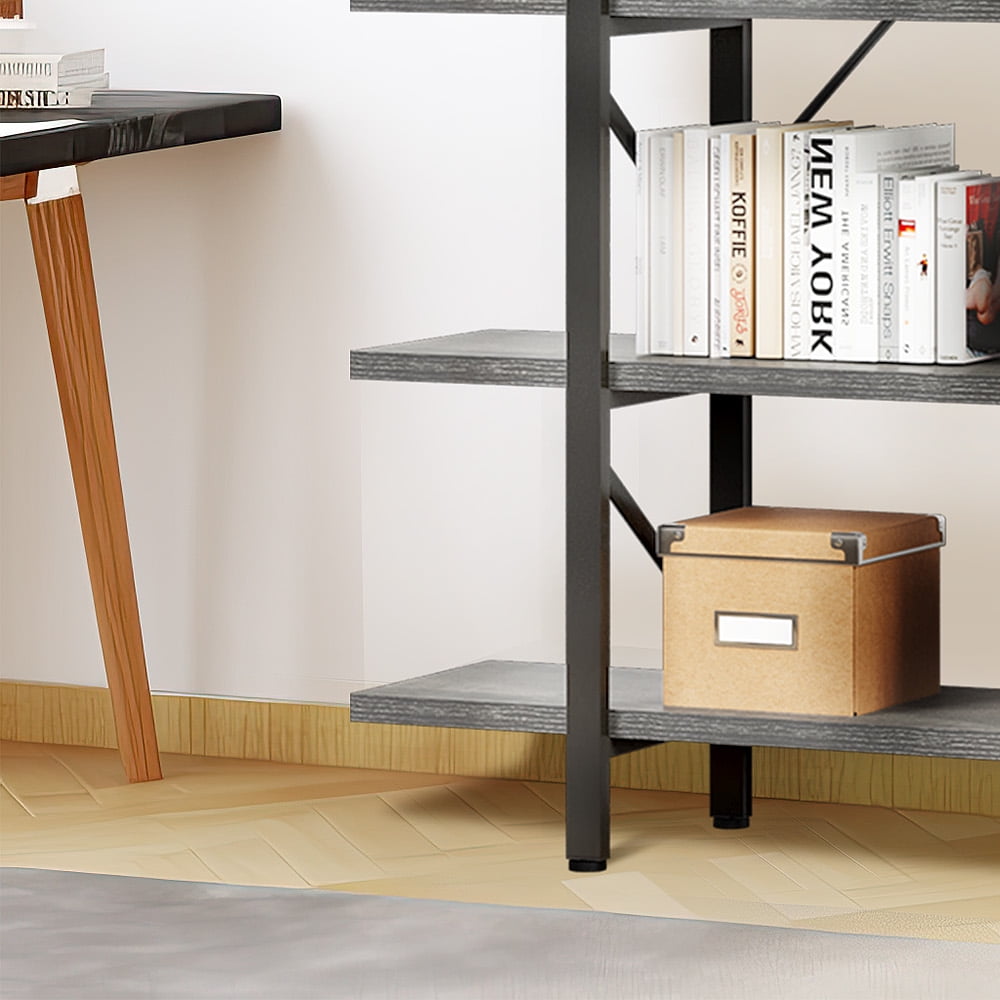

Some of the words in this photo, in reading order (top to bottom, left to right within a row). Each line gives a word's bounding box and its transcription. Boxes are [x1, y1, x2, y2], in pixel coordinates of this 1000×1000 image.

[731, 191, 746, 258] KOFFIE
[883, 176, 895, 222] Elliott
[883, 228, 895, 276] Erwitt
[883, 282, 894, 339] Snaps
